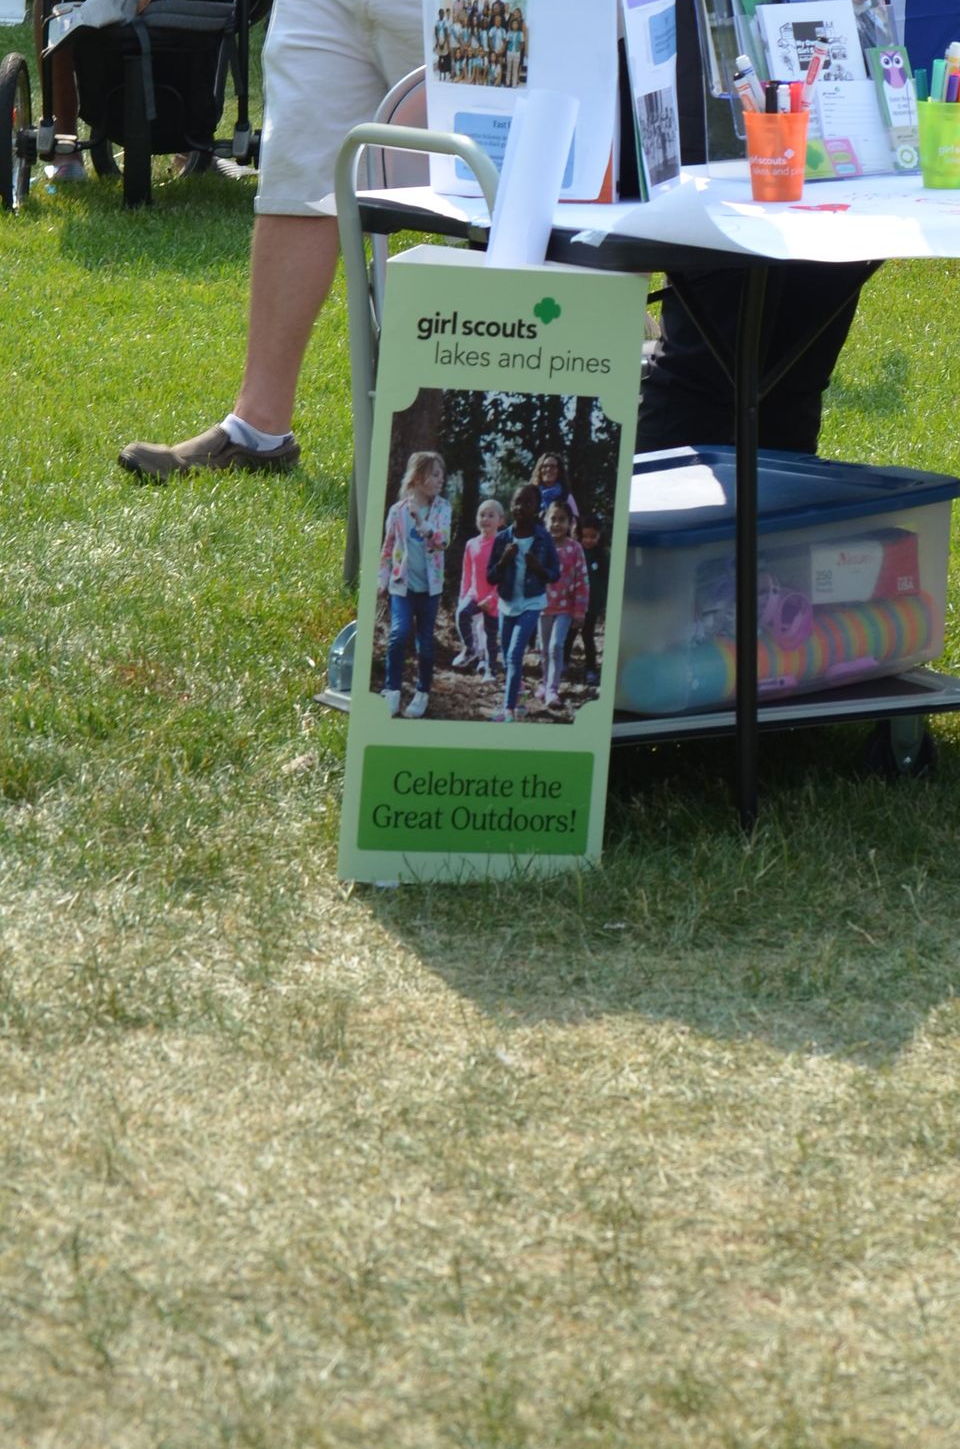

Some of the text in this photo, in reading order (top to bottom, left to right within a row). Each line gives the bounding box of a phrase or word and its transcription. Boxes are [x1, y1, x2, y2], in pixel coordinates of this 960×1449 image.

[760, 157, 787, 165] scouts
[417, 311, 538, 340] girl scouts
[434, 341, 611, 379] lakes and pines
[393, 770, 562, 799] Celebrate the
[372, 804, 577, 833] Great Outdoors!
